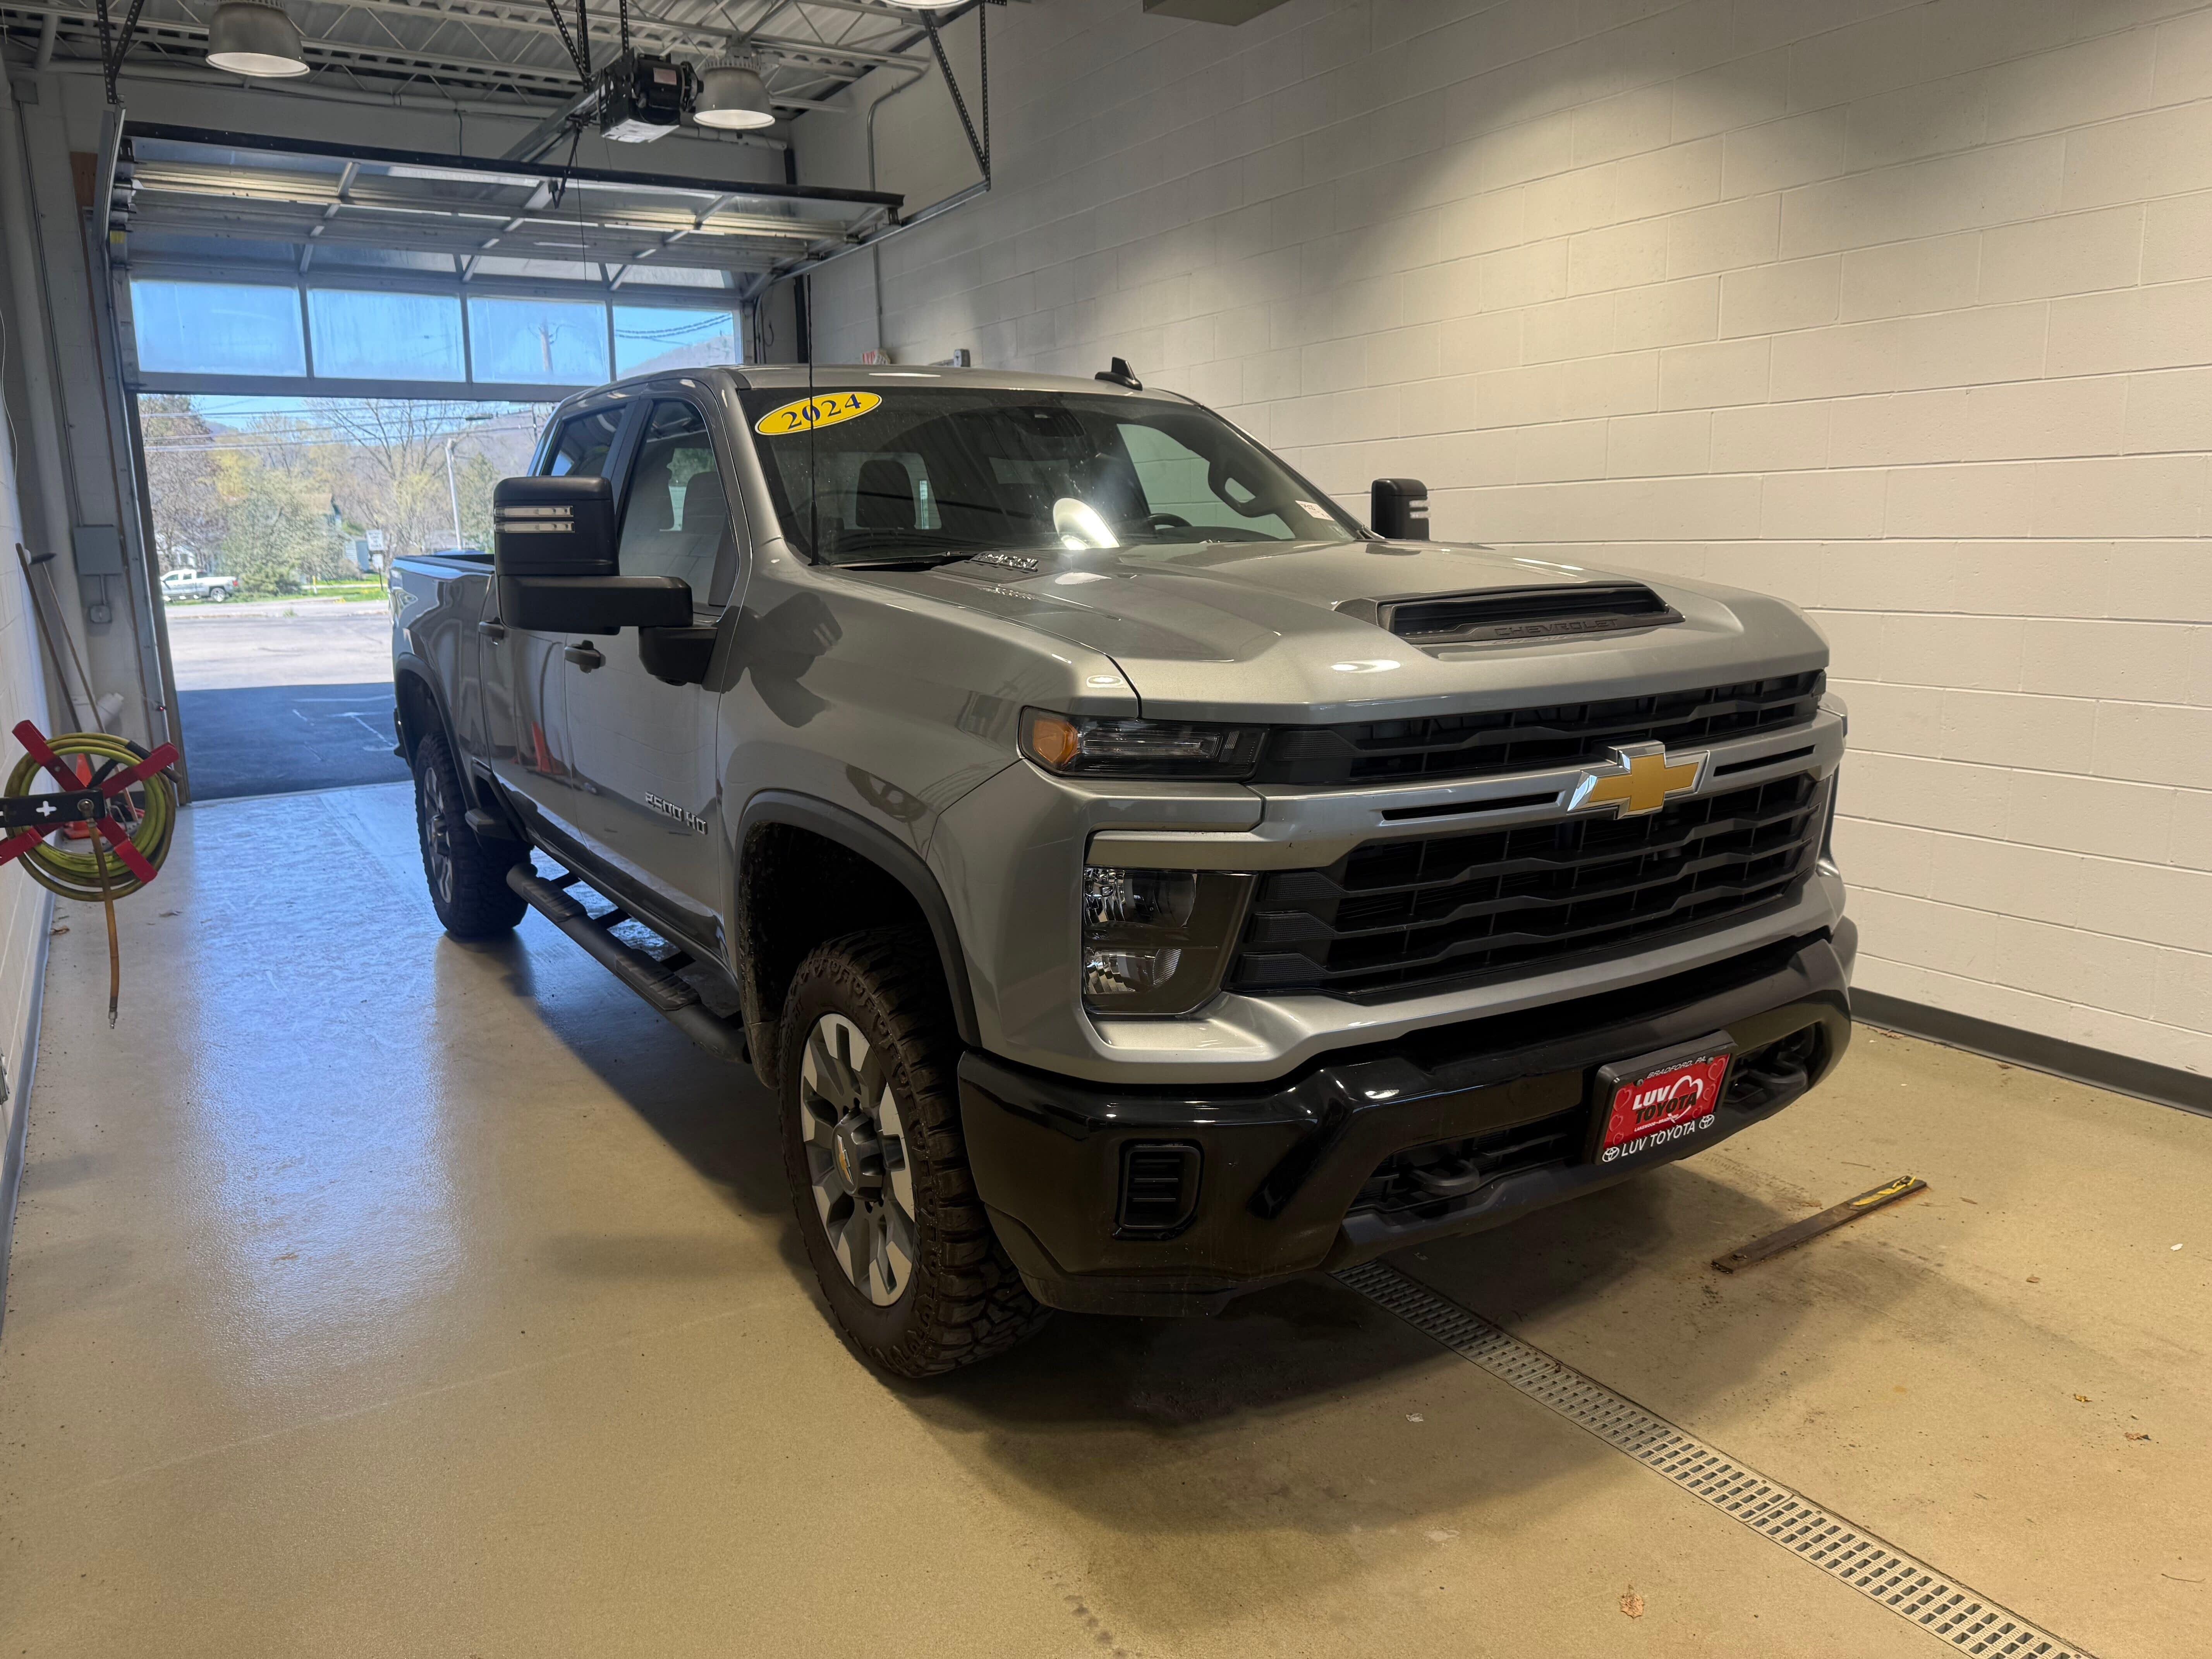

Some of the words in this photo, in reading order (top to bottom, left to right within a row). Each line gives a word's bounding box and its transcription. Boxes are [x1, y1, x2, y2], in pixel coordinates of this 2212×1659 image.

[781, 393, 862, 430] 2024
[1494, 619, 1618, 636] CHEVROLET
[645, 792, 684, 822] 2500
[686, 811, 708, 835] HD
[1632, 1085, 1671, 1110] LUV
[1635, 1092, 1697, 1125] TOYOTA
[1621, 1137, 1647, 1157] LUV
[1650, 1120, 1695, 1147] TOYOTA
